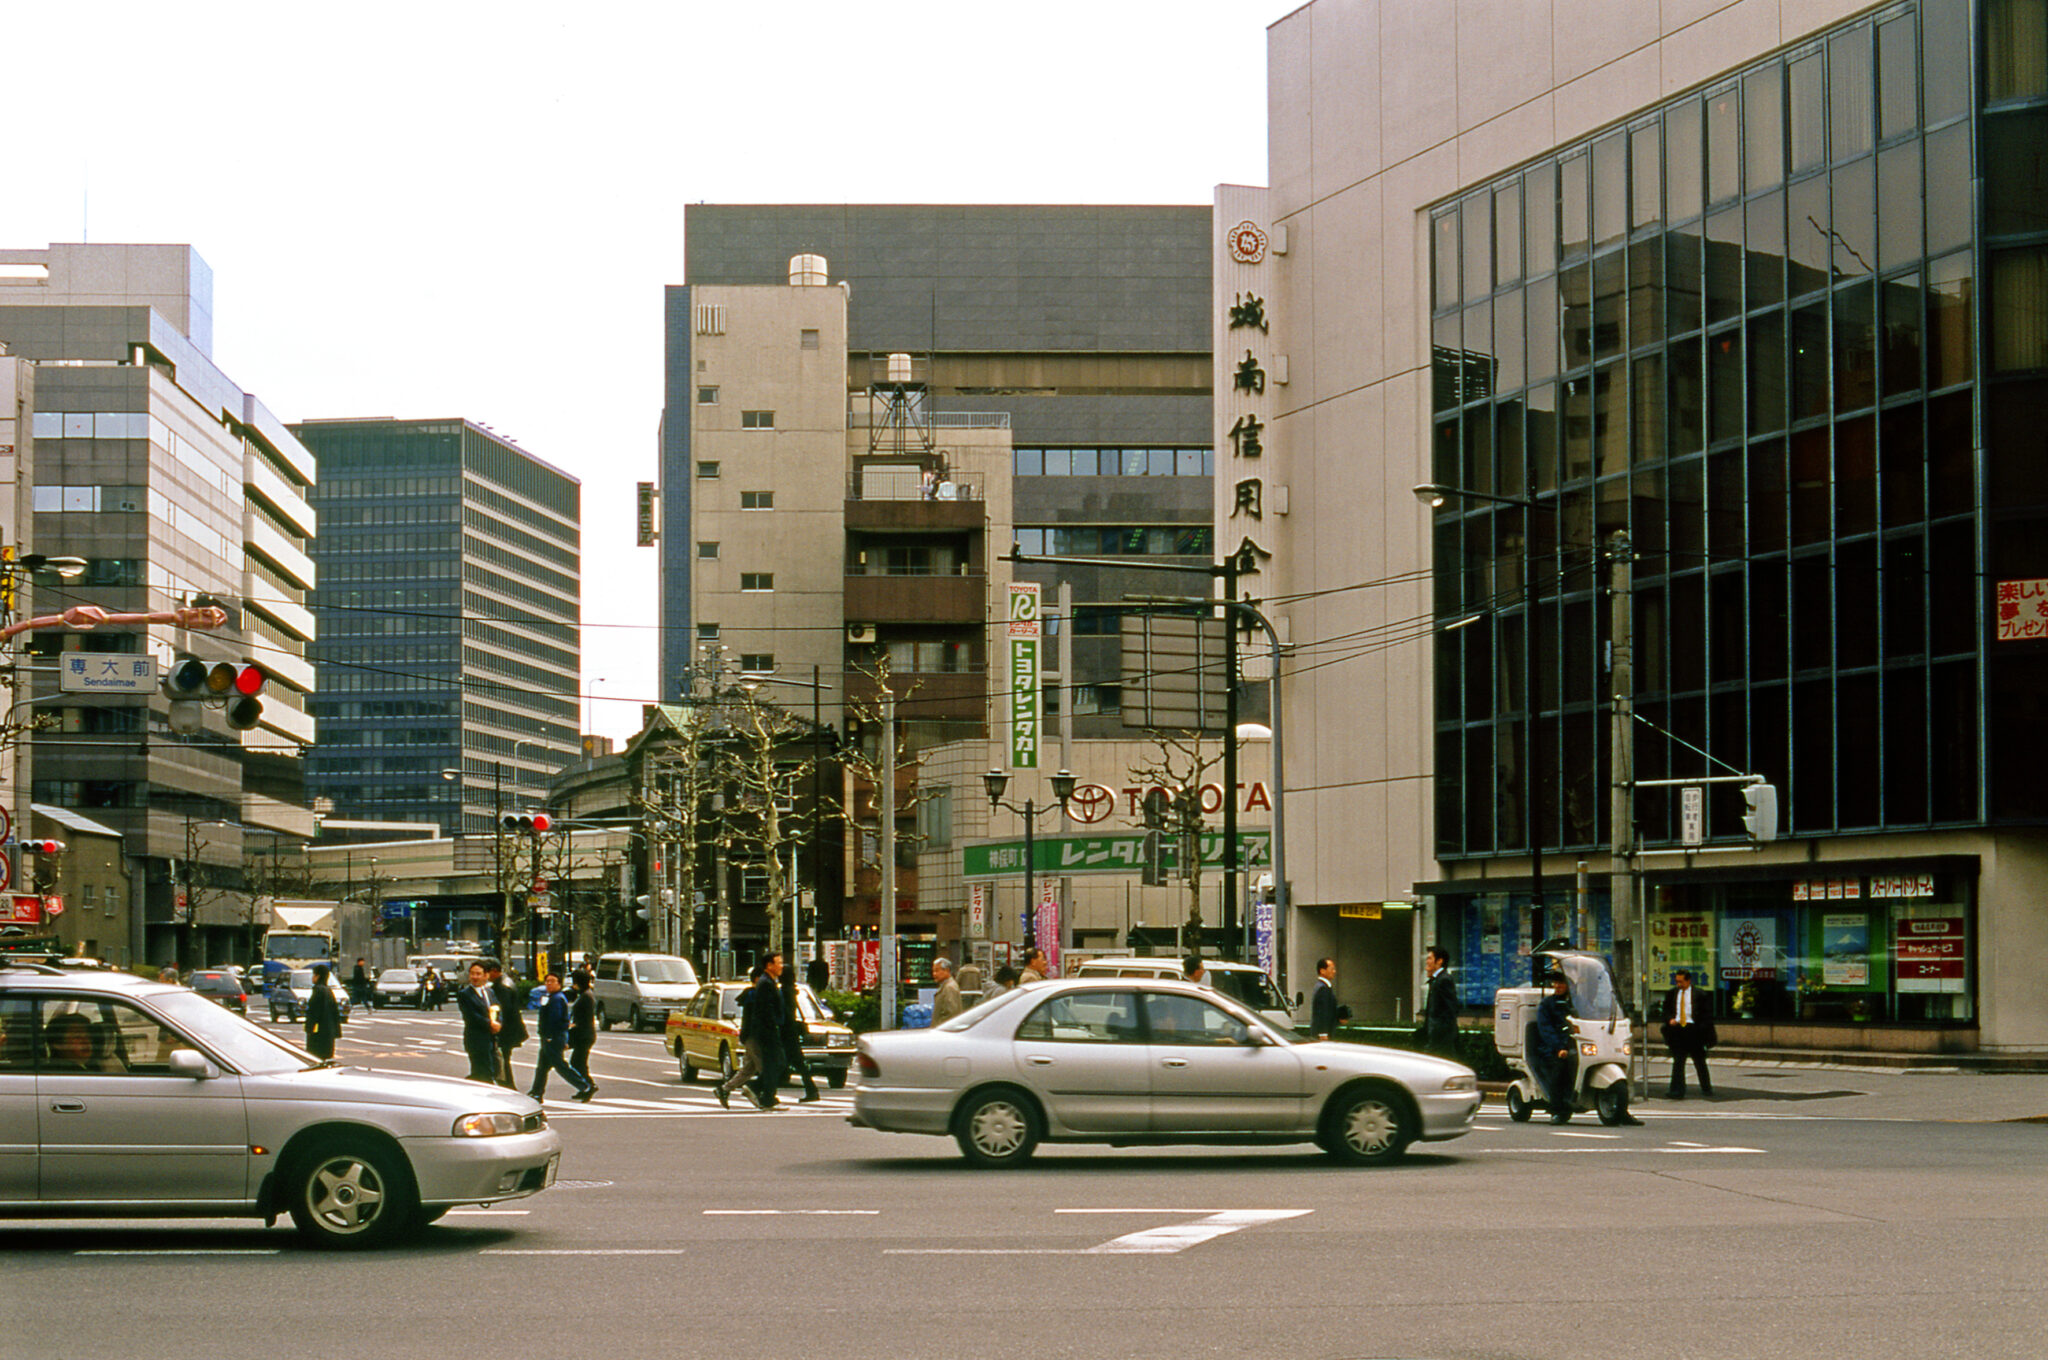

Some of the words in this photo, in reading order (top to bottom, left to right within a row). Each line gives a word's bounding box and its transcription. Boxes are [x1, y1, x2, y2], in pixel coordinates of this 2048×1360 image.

[1009, 585, 1039, 593] TOYOTA
[70, 658, 150, 677] 専大前
[1015, 643, 1034, 766] トヨタレンタカー
[1871, 877, 1932, 896] スーパードリーム
